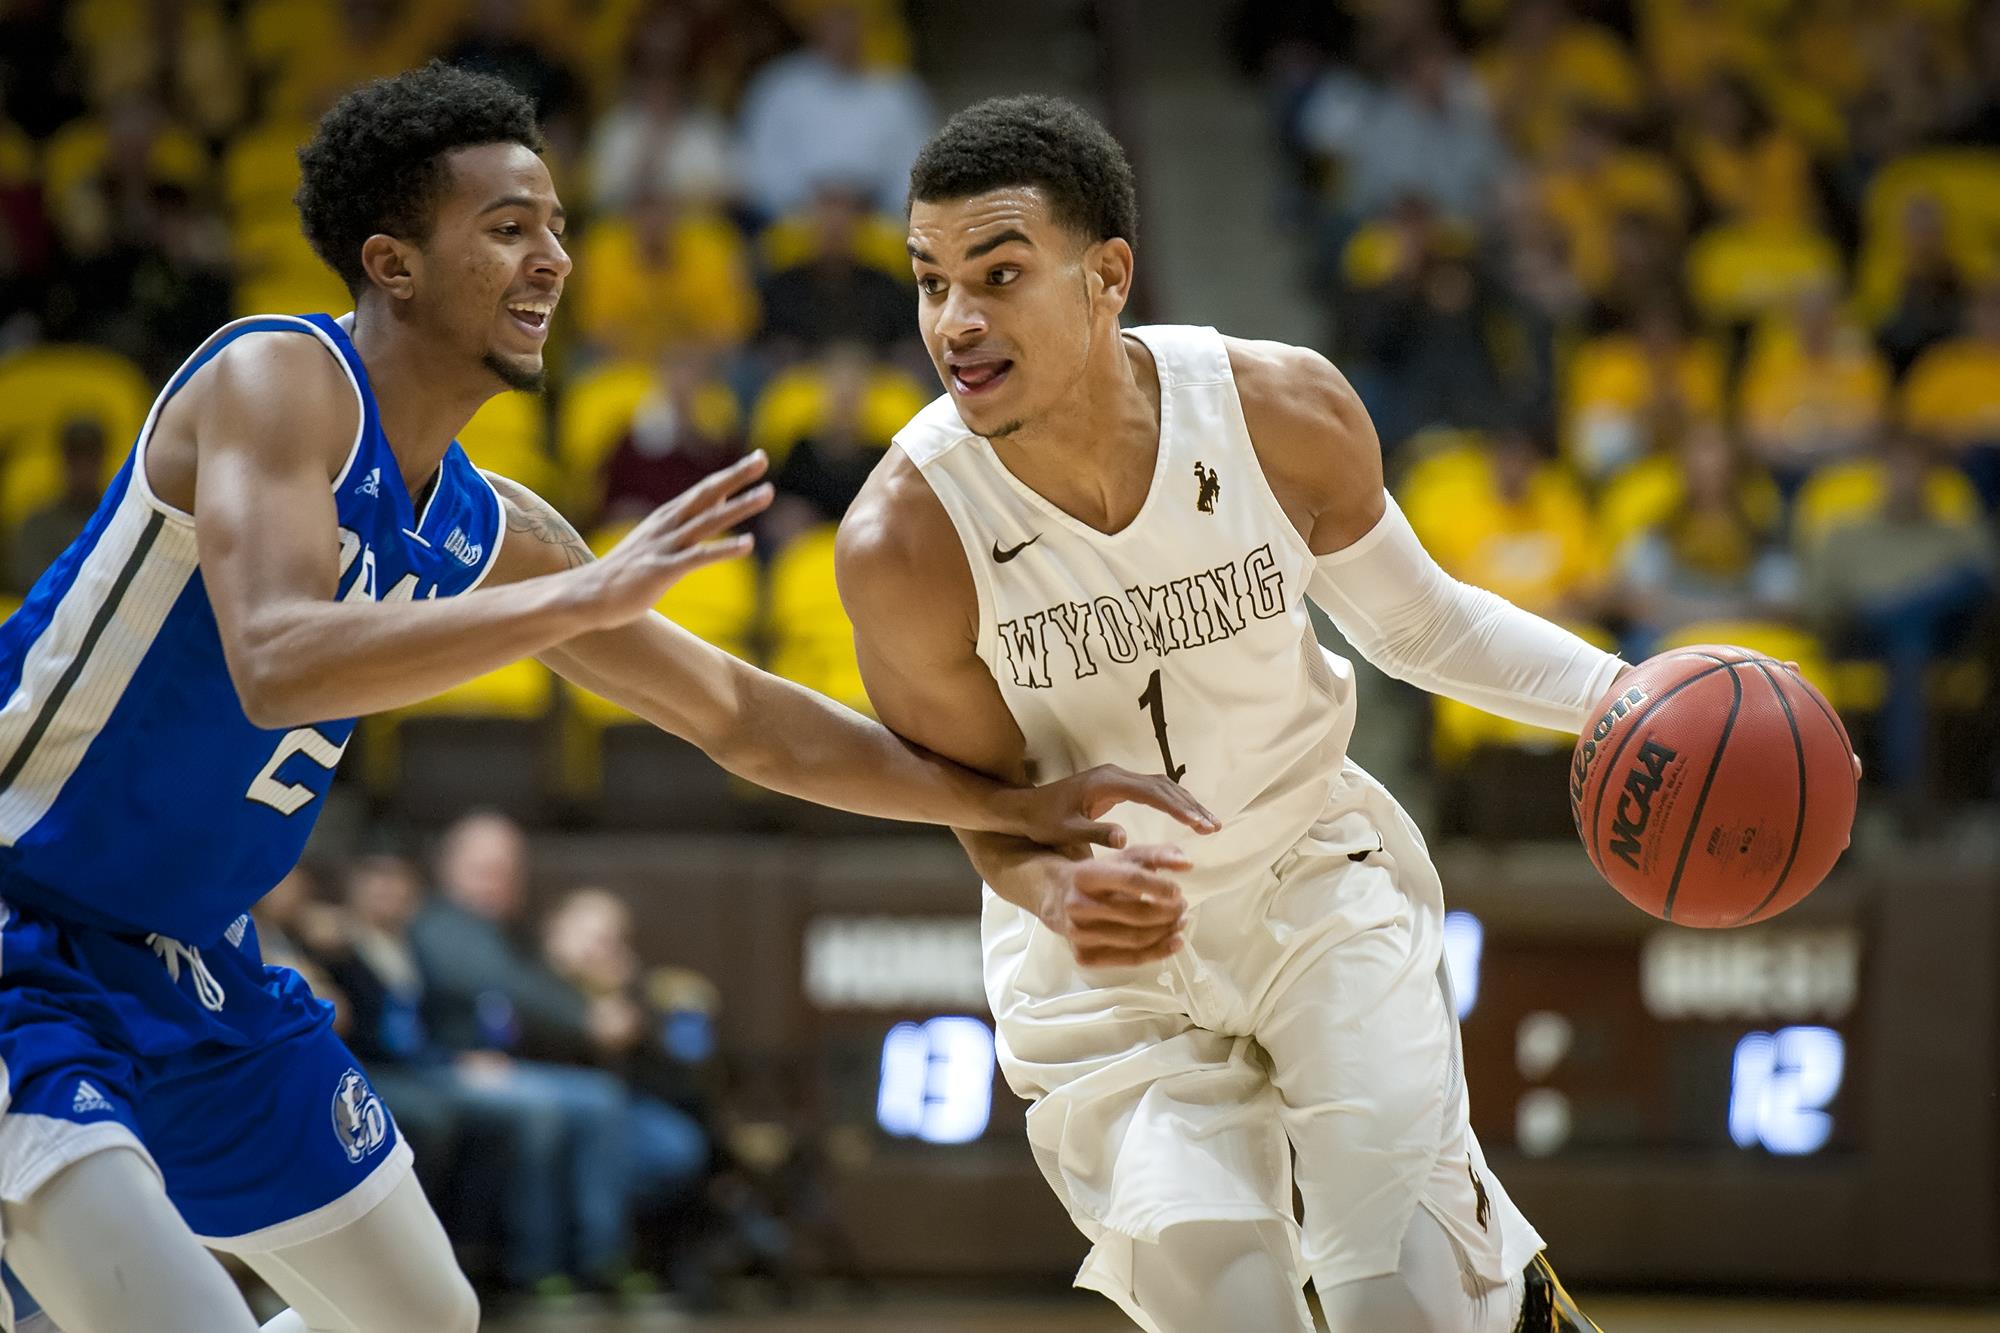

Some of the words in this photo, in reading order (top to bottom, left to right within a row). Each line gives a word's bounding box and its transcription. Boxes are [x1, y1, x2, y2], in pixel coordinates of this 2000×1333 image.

[997, 543, 1286, 690] WYOMING
[1137, 668, 1187, 785] 1
[1608, 739, 1678, 871] NCAA
[876, 1015, 996, 1140] 13
[1728, 1026, 1845, 1156] 12
